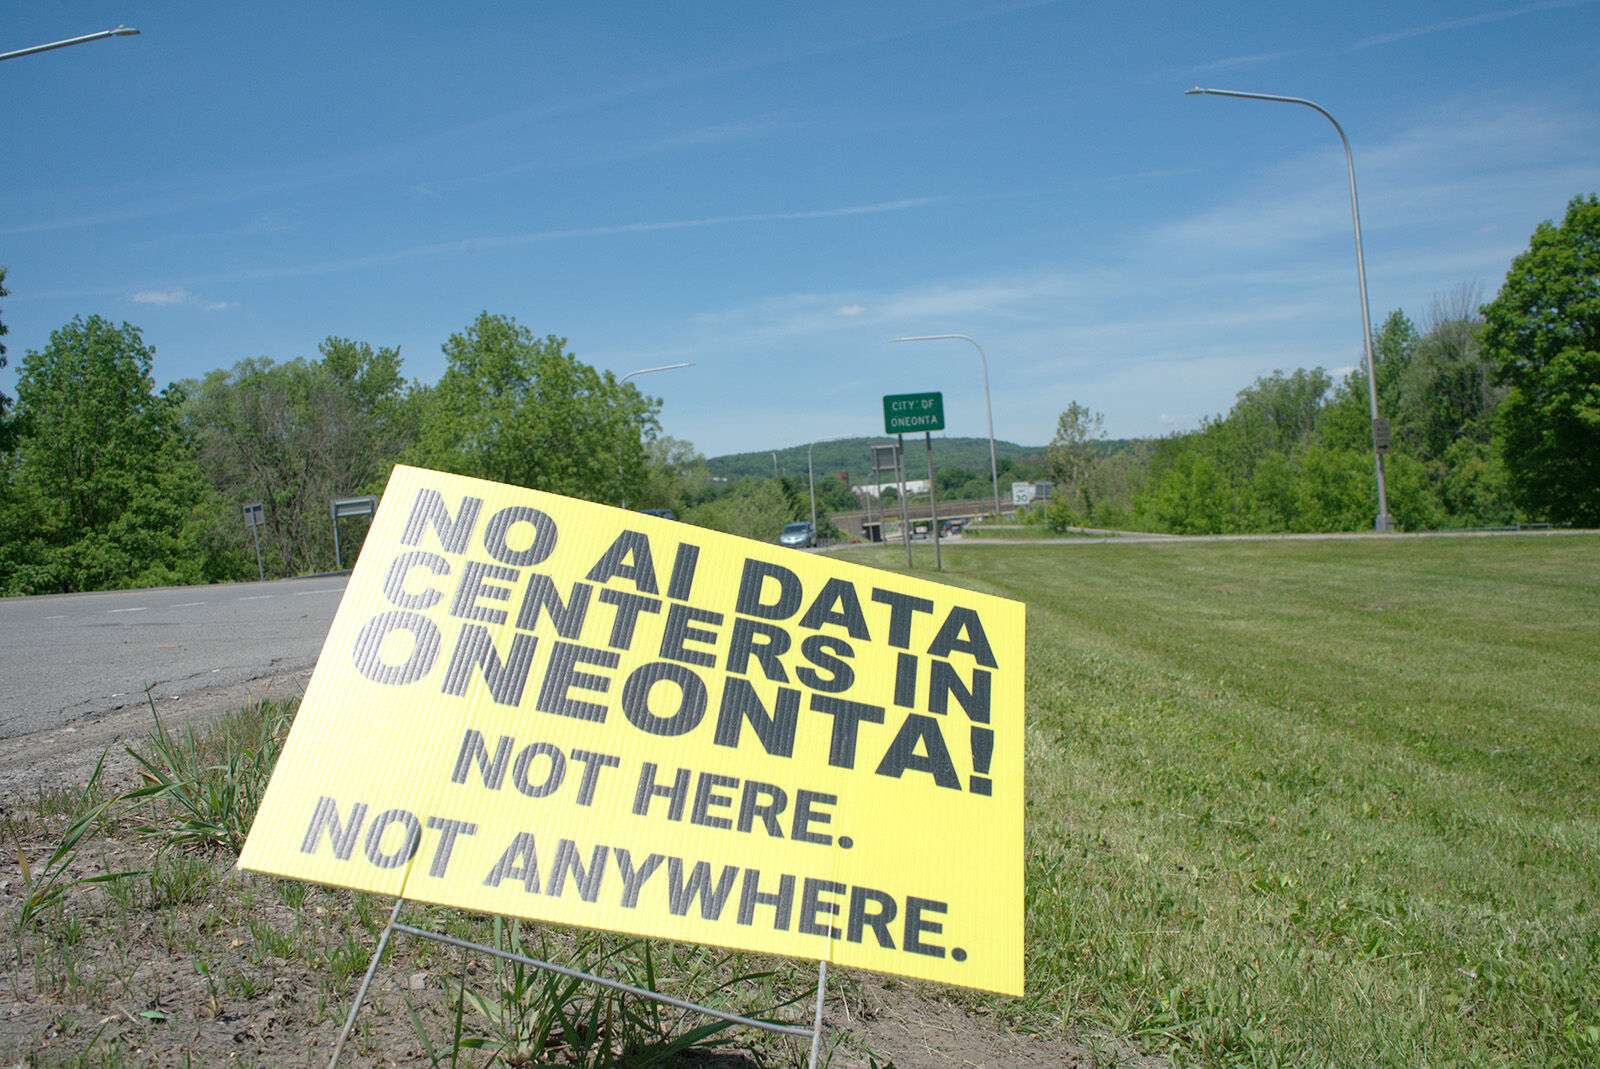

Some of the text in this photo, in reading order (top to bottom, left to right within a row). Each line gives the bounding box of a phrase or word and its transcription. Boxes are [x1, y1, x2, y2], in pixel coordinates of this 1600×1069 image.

[891, 415, 938, 427] ONEONTA
[892, 399, 934, 410] CITY OF
[382, 551, 991, 724] CENTERS IN
[400, 488, 997, 668] NO AI DATA
[353, 610, 995, 796] ONEONTA!
[451, 729, 852, 849] NOT HERE.
[300, 797, 967, 962] NOT ANYWHERE.
